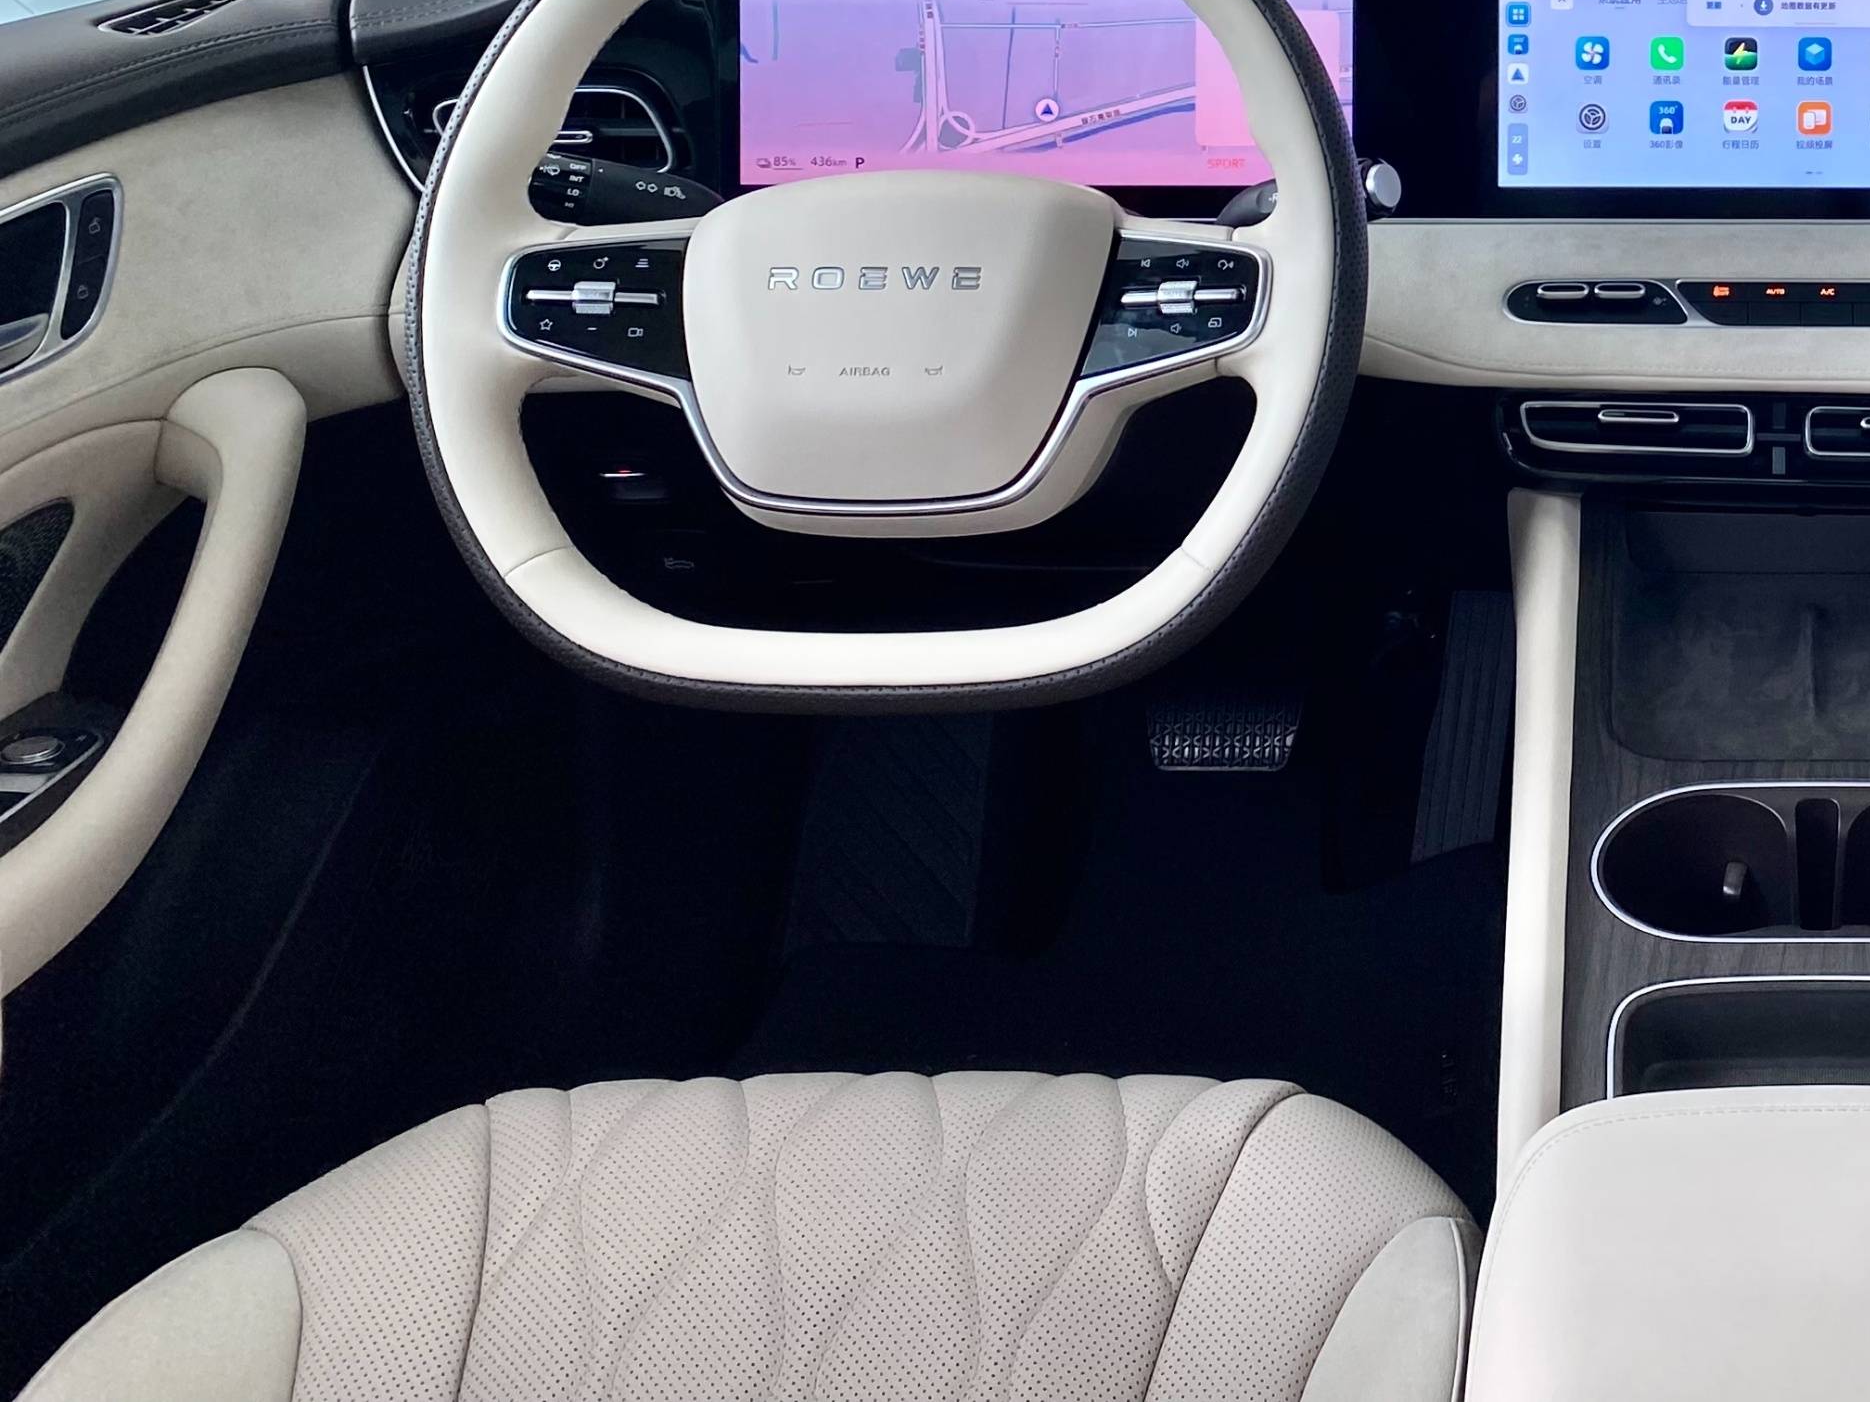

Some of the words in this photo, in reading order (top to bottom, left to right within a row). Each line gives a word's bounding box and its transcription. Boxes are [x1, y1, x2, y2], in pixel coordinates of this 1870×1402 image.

[1583, 75, 1603, 85] 空调
[1652, 75, 1681, 85] 通讯录
[1722, 75, 1760, 86] 能量管理
[1796, 76, 1833, 86] 我的场景
[1730, 115, 1751, 124] DAY
[1511, 135, 1522, 143] 22
[1649, 139, 1684, 149] 360影像
[1722, 139, 1760, 150] 行程日历
[773, 156, 796, 166] 85%
[810, 156, 848, 166] 436km
[855, 157, 865, 169] P
[1207, 158, 1246, 169] SPORT
[768, 266, 982, 290] ROEWE
[1820, 288, 1836, 296] A/C
[839, 366, 891, 377] AIRBAG
